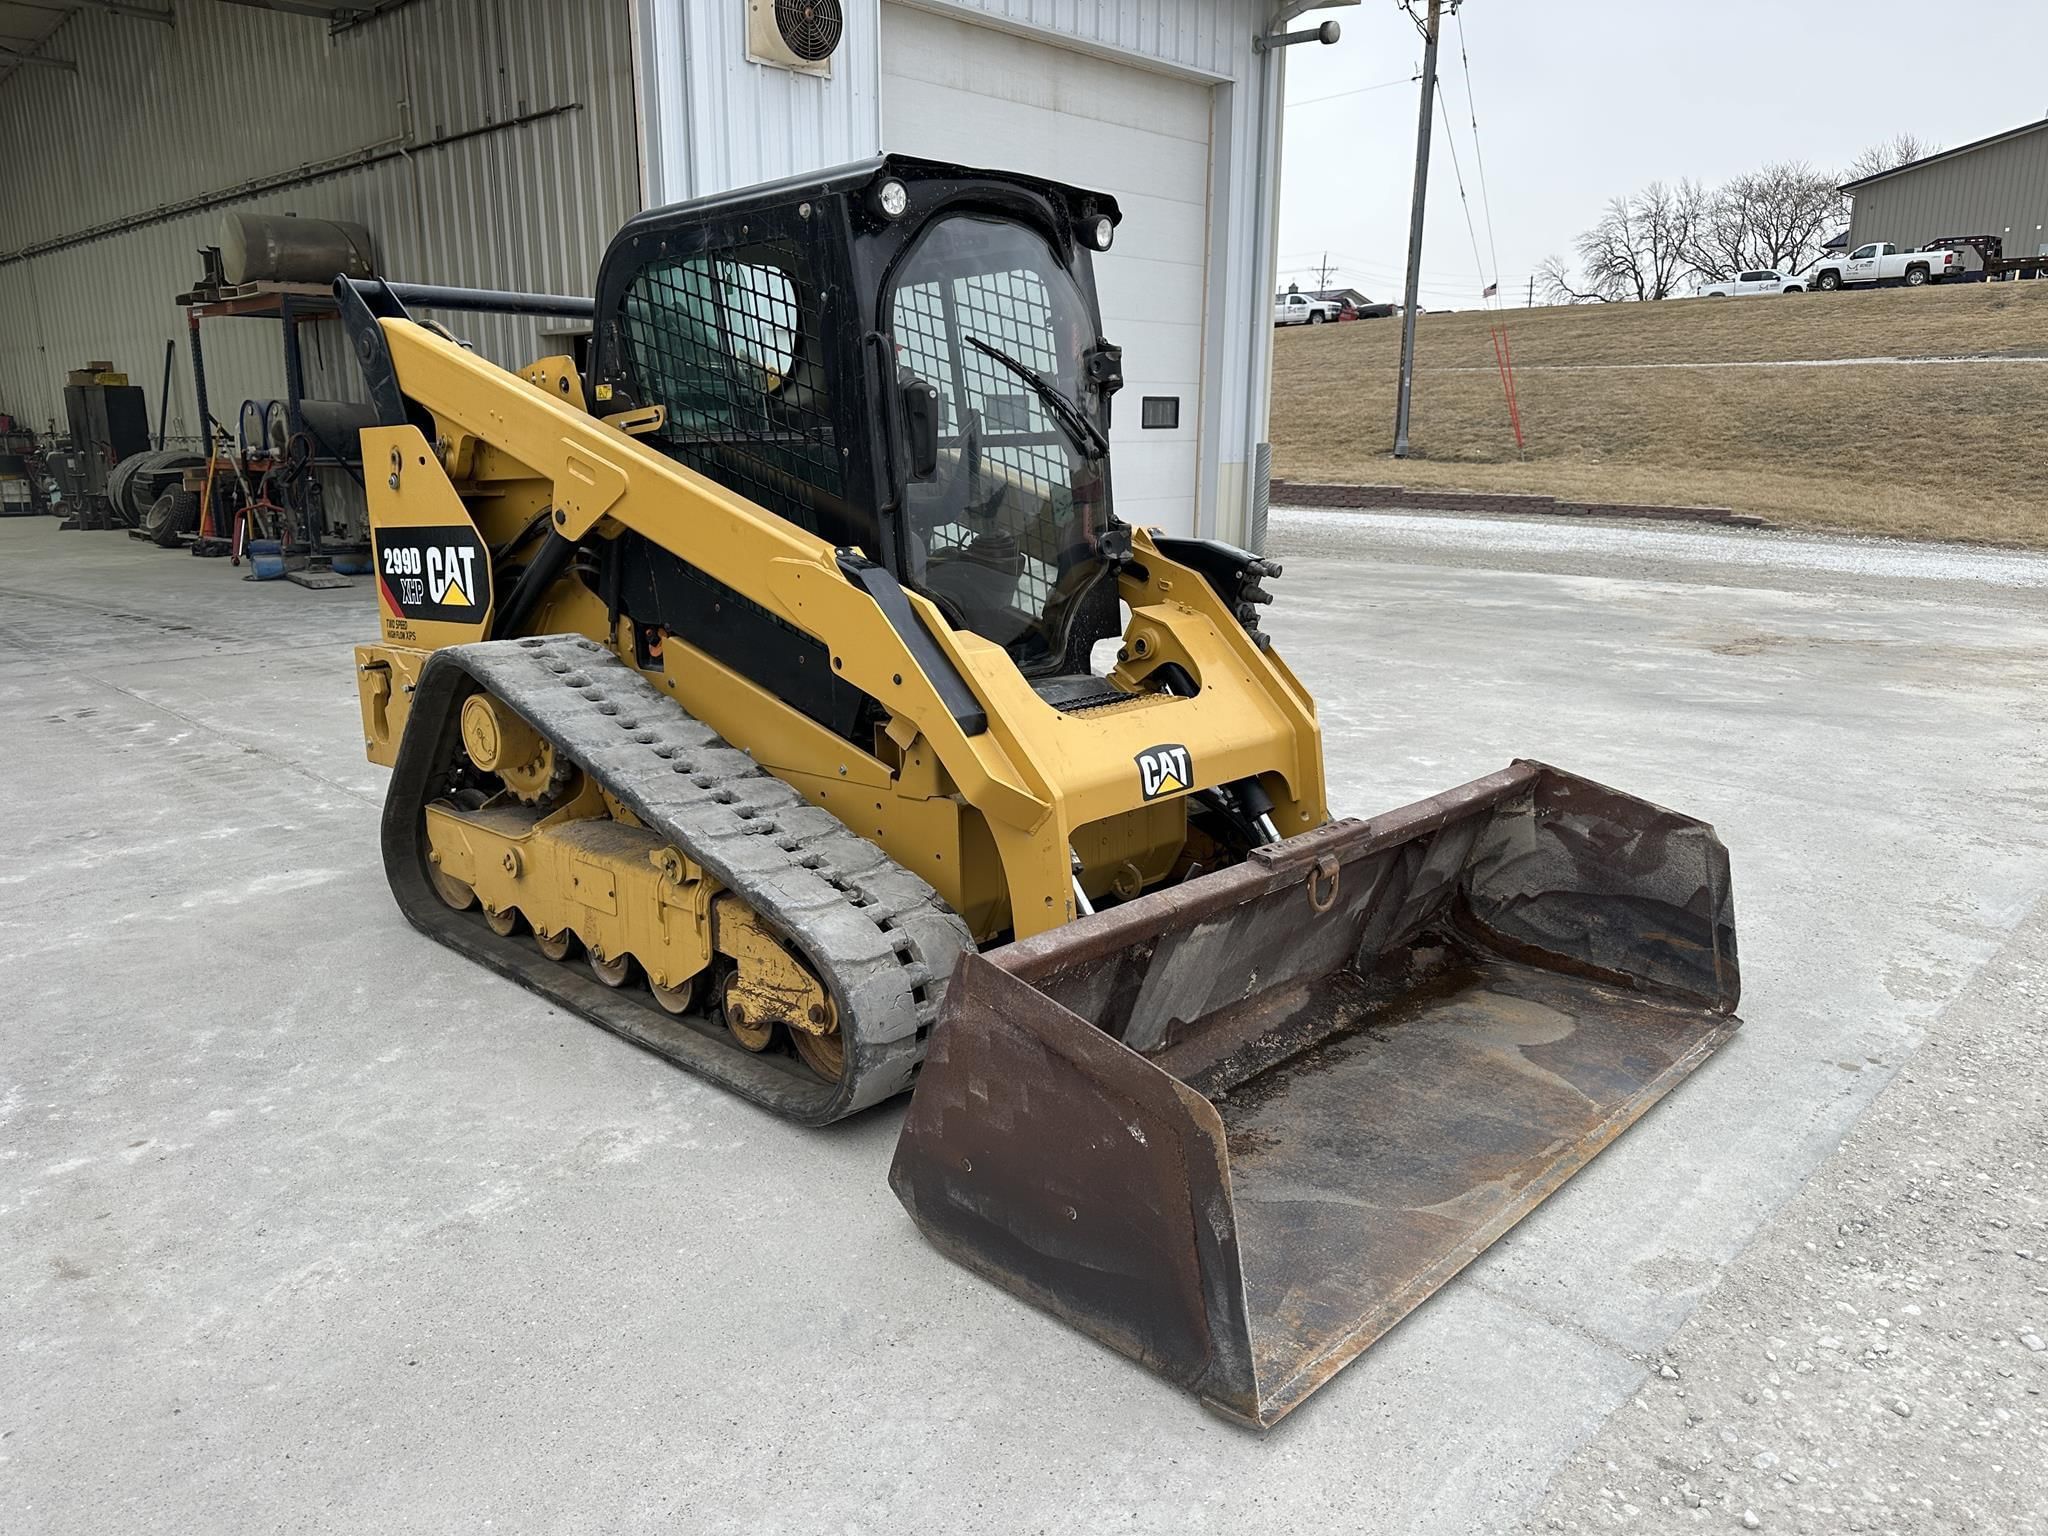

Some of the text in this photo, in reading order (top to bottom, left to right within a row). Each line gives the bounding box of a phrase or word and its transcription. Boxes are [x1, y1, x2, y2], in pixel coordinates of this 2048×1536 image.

[384, 547, 421, 574] 299D
[426, 546, 475, 606] CAT
[400, 578, 424, 604] XHP
[386, 619, 408, 630] TWO SPEED
[406, 631, 416, 641] XPS
[1139, 747, 1188, 796] CAT
